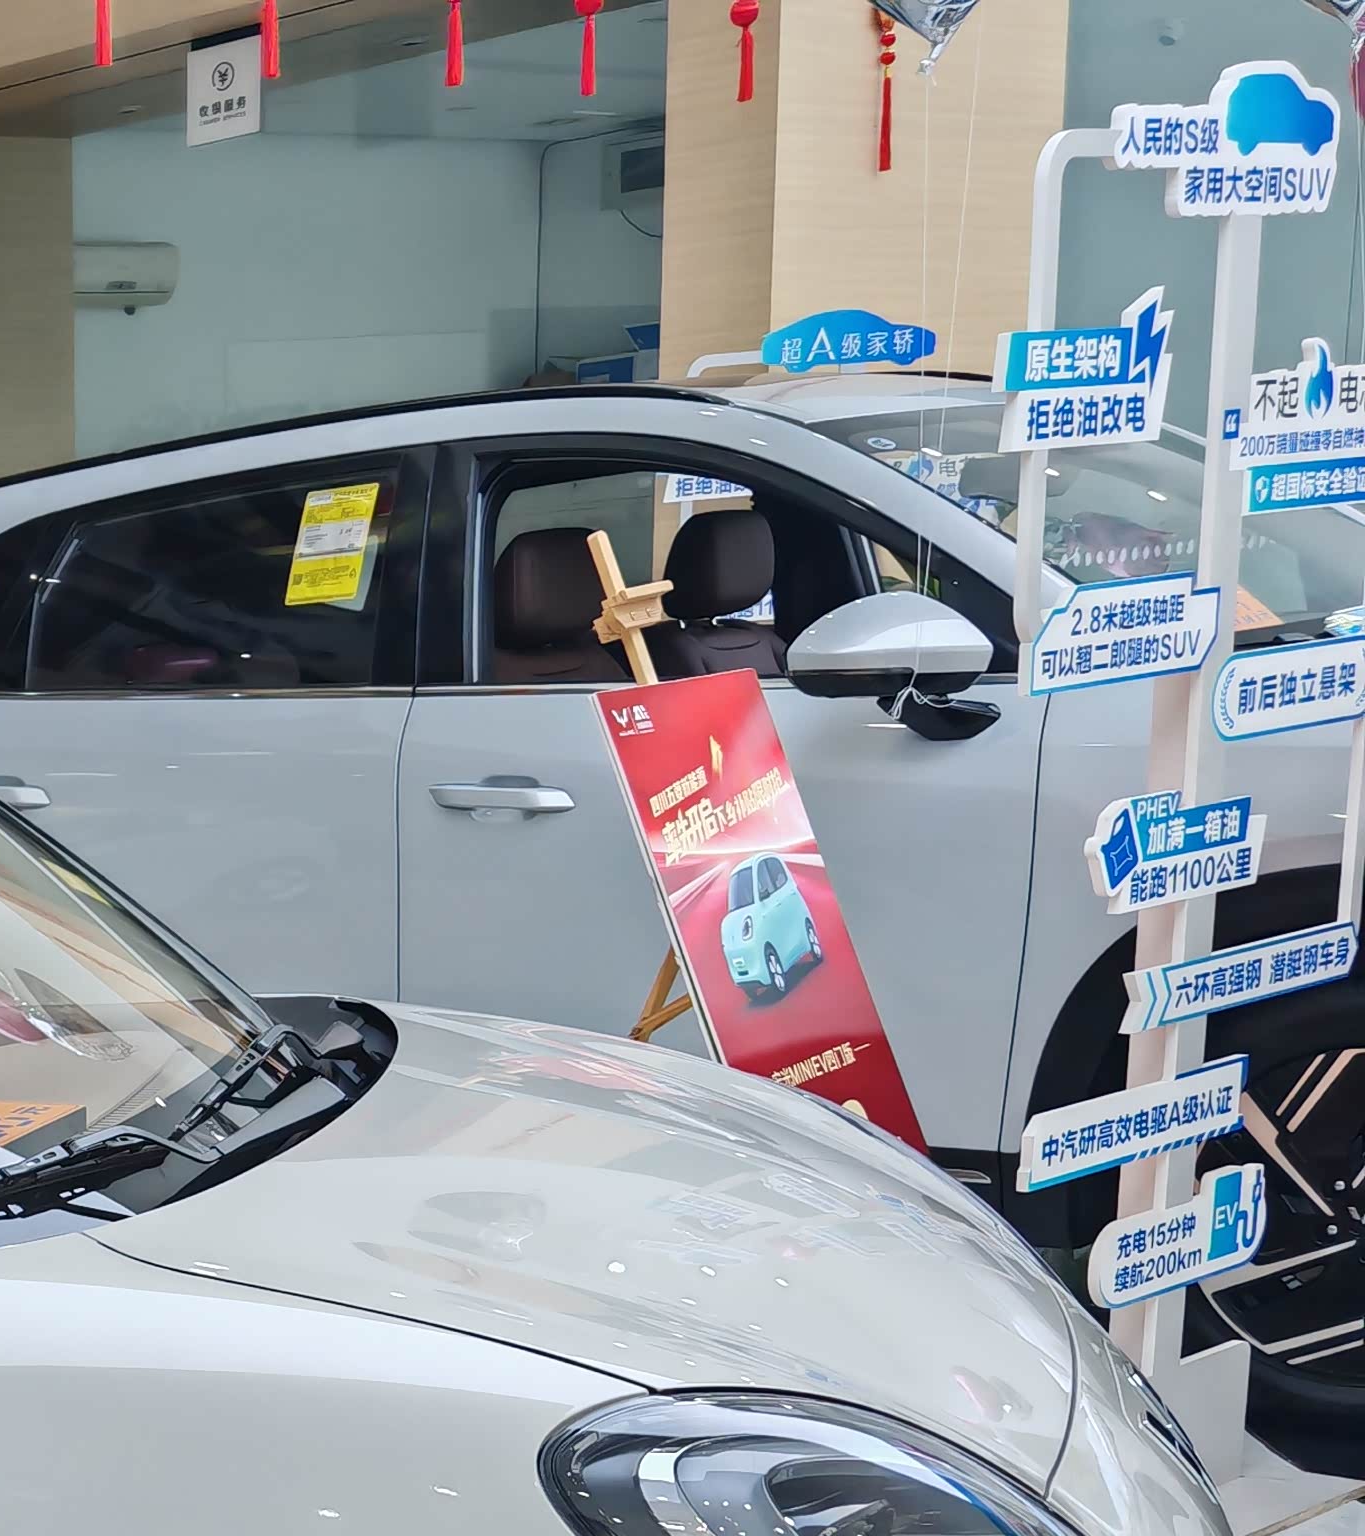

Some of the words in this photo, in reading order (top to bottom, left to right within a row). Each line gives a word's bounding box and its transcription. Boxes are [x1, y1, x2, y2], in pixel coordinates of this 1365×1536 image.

[1122, 117, 1219, 155] 人民的S级
[1184, 166, 1333, 204] 家用大空间SUV
[781, 327, 915, 364] 超A级家轿
[1024, 335, 1122, 382] 原生架构
[1027, 392, 1146, 441] 拒绝油改电
[1070, 594, 1185, 637] 2.8米越级轴距
[1040, 629, 1201, 680] 可以翘二郎腿的SUV
[1236, 662, 1357, 715] 前后独立悬架
[1137, 794, 1180, 822] PHEV
[1146, 806, 1242, 855] 加满一箱油
[1129, 847, 1252, 905] 能跑1100公里
[1174, 962, 1262, 1009] 六环高强钢
[1268, 935, 1350, 984] 潜艇钢车身
[1041, 1084, 1234, 1168] 中汽研高效电驱A级认证
[1116, 1213, 1197, 1260] 充电15分钟
[1215, 1203, 1238, 1230] EV
[1114, 1247, 1202, 1294] 续航200km
